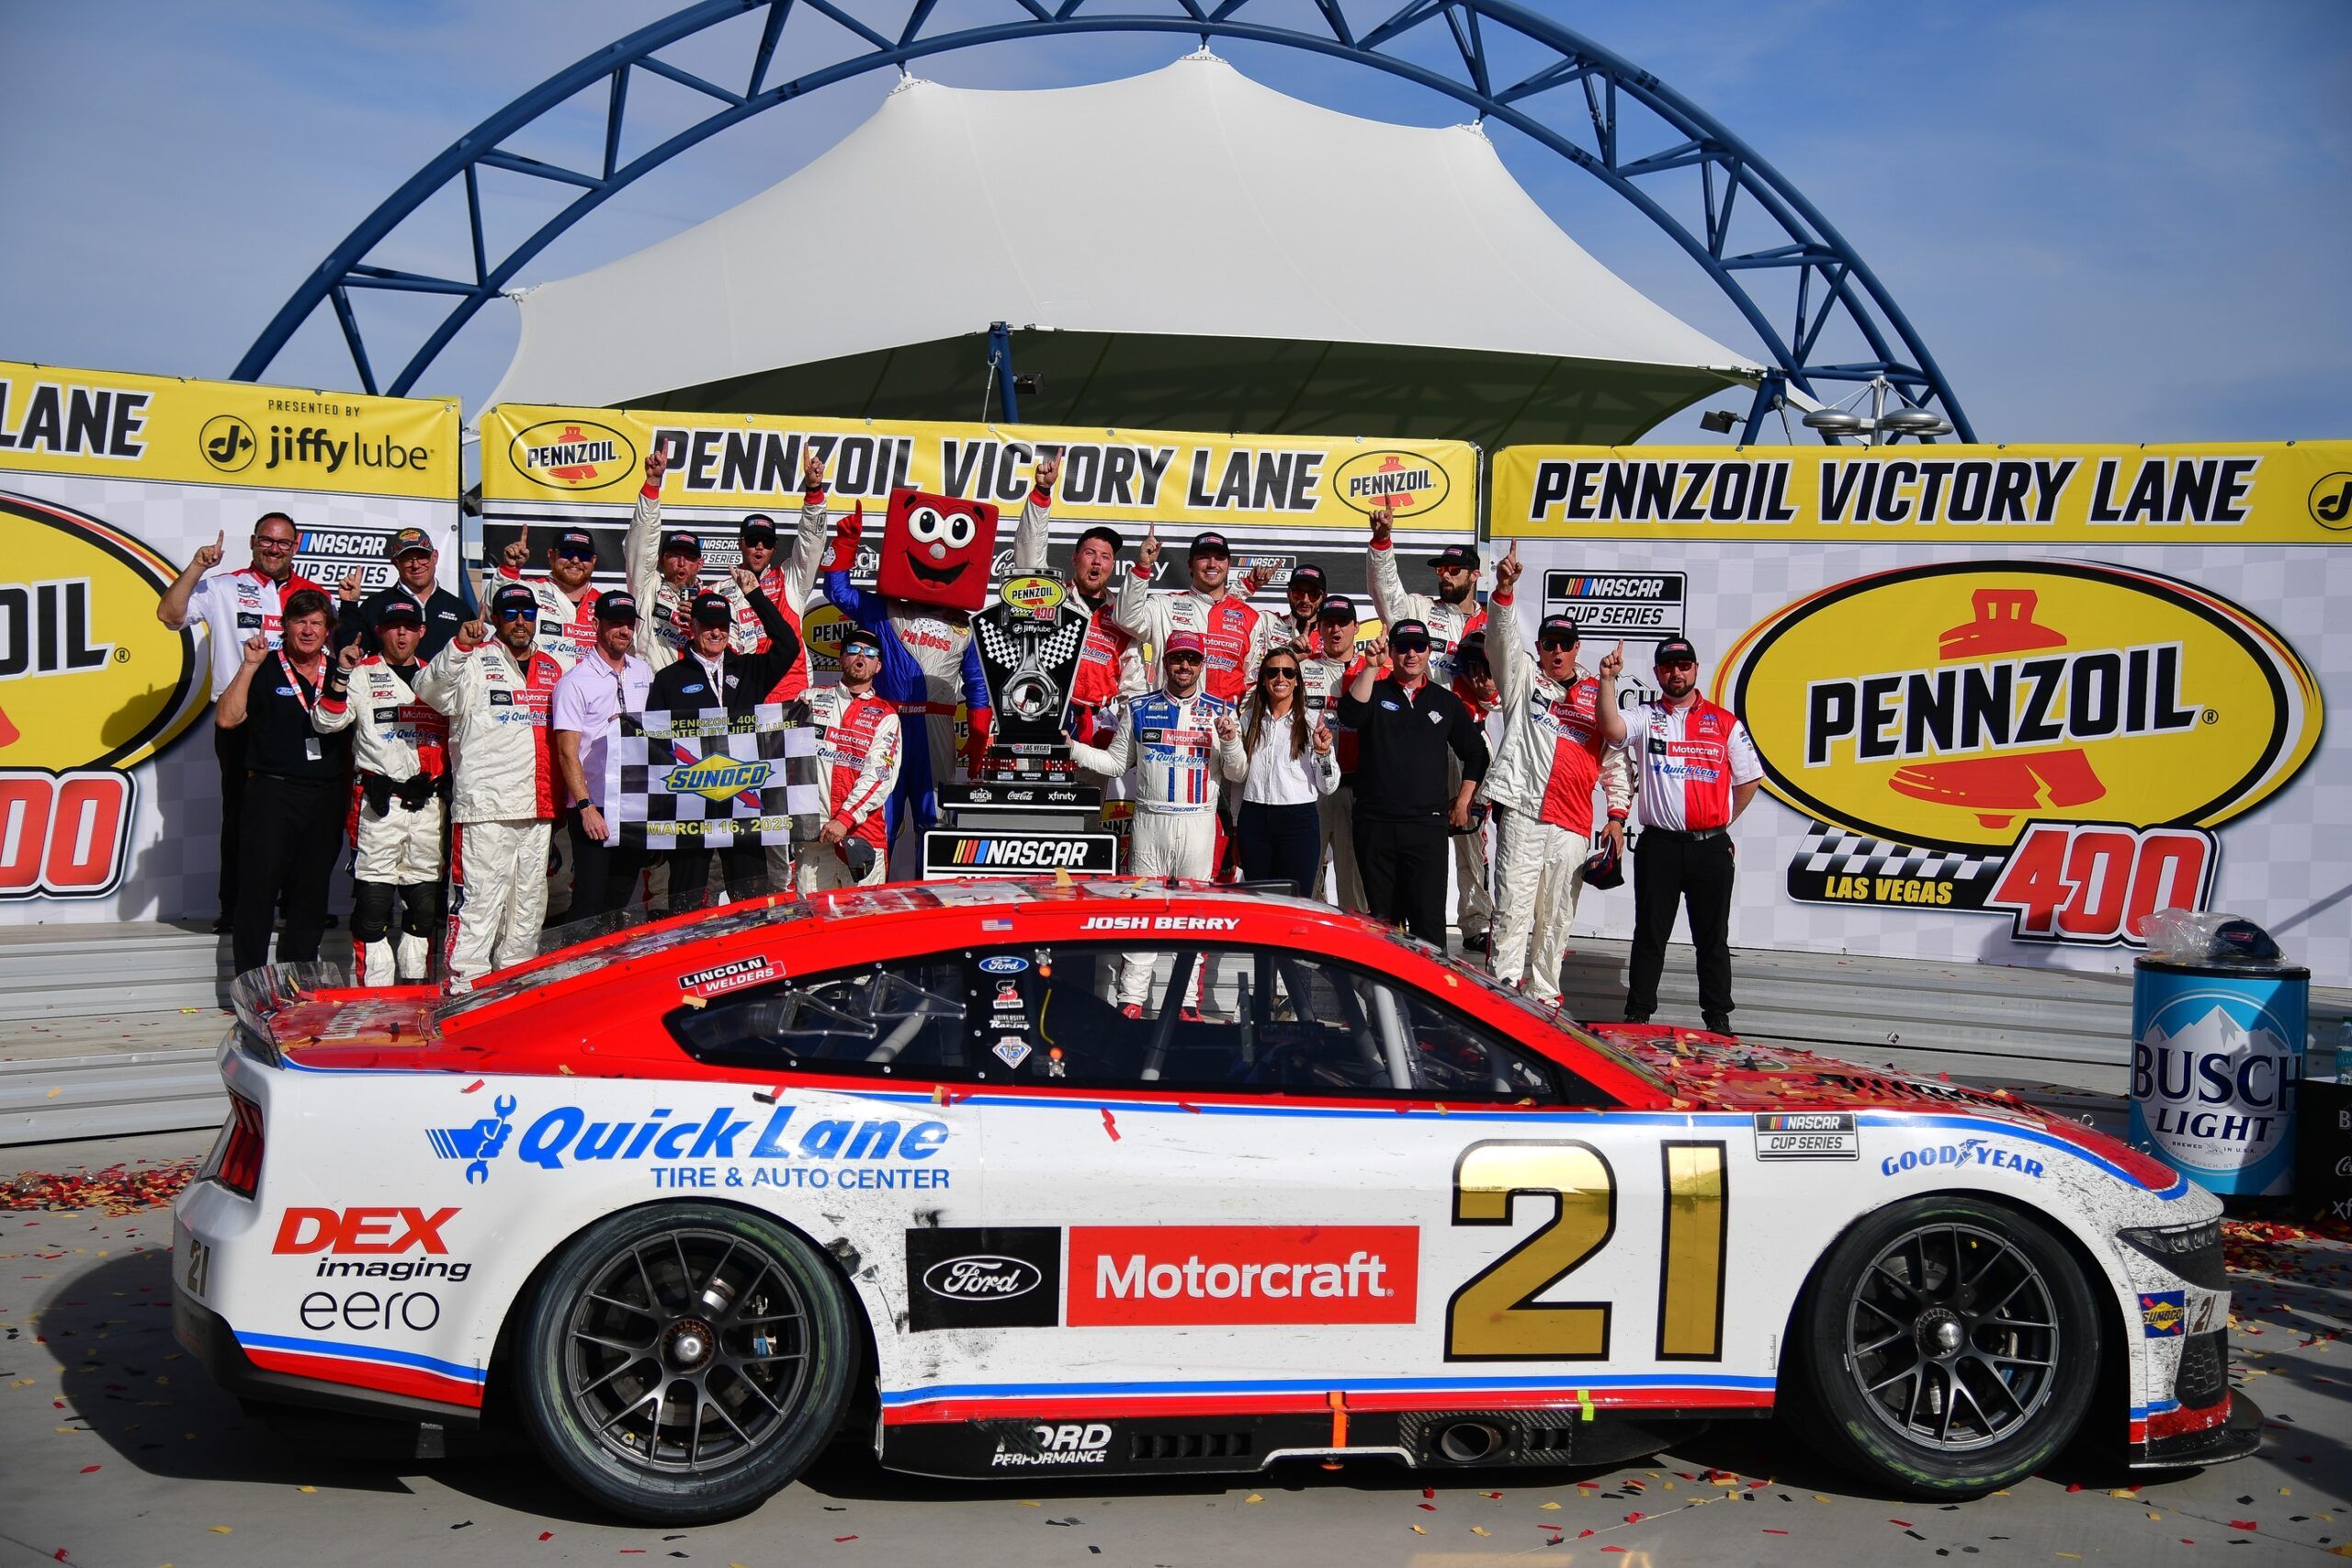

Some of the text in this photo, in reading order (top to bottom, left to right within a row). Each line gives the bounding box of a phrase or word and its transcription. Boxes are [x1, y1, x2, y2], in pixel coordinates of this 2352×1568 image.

[268, 400, 360, 417] PRESENTED BY
[527, 440, 617, 468] PENNZOIL
[653, 429, 921, 497] PENNZOIL
[1193, 446, 1327, 512] LANE
[1349, 473, 1434, 498] PENNZOIL
[1530, 457, 2262, 525] PENNZOIL VICTORY LANE
[308, 533, 387, 556] NASCAR
[701, 539, 739, 550] NASCAR
[708, 553, 741, 564] SERIES
[294, 563, 320, 581] UP
[1012, 586, 1054, 600] PENNZOIL
[1589, 578, 1664, 598] NASCAR
[540, 604, 558, 614] DEX
[1034, 606, 1056, 620] 400
[1564, 606, 1664, 626] CUP SERIES
[1172, 615, 1191, 624] DEX
[1428, 621, 1446, 630] DEX
[559, 642, 586, 653] Quick
[1203, 637, 1238, 649] otorcraft
[1216, 655, 1236, 667] Lane
[1806, 643, 2199, 766] PENNZOIL
[511, 712, 536, 721] Quick
[671, 715, 759, 729] PENNZOIL 400
[708, 727, 725, 736] BY
[729, 724, 763, 735] JIFFY
[766, 720, 798, 732] LUBE
[1544, 717, 1592, 741] Quick Lane
[829, 730, 870, 748] Motorcraft
[1166, 733, 1209, 744] Motorcraft
[817, 747, 844, 760] Quick
[1156, 751, 1210, 764] Quick Lane
[1672, 745, 1719, 756] Motorcraft
[671, 766, 766, 789] SUNOCO
[1663, 763, 1720, 778] Quick Lane
[969, 792, 992, 801] BUSCH
[1047, 791, 1078, 802] xfinity
[646, 817, 794, 836] MARCH 16, 2025
[986, 840, 1090, 866] NASCAR
[1825, 875, 1953, 905] LAS VEGAS
[1992, 829, 2206, 938] 400
[1080, 917, 1240, 931] JOSH BERRY
[684, 957, 766, 987] LINCOLN
[988, 958, 1019, 970] Ford
[706, 968, 775, 993] WELDERS
[989, 1020, 1031, 1030] Racing
[2132, 1042, 2304, 1113] BUSCH
[1785, 1116, 1839, 1131] NASCAR
[2154, 1108, 2275, 1142] LIGHT
[518, 1105, 951, 1170] Quick Lane
[1770, 1136, 1843, 1150] CUP SERIES
[2172, 1141, 2203, 1149] BREWED
[650, 1168, 950, 1190] TIRE & AUTO CENTER
[272, 1207, 463, 1255] DEX
[1444, 1139, 1727, 1363] 21
[187, 1239, 211, 1298] 21
[315, 1257, 472, 1282] imaging
[945, 1250, 1388, 1300] Ford Motorcraft
[300, 1291, 440, 1331] eero
[2142, 1307, 2183, 1324] SUNOCO
[997, 1424, 1113, 1452] ORD
[992, 1450, 1107, 1467] PERFORMANCE
